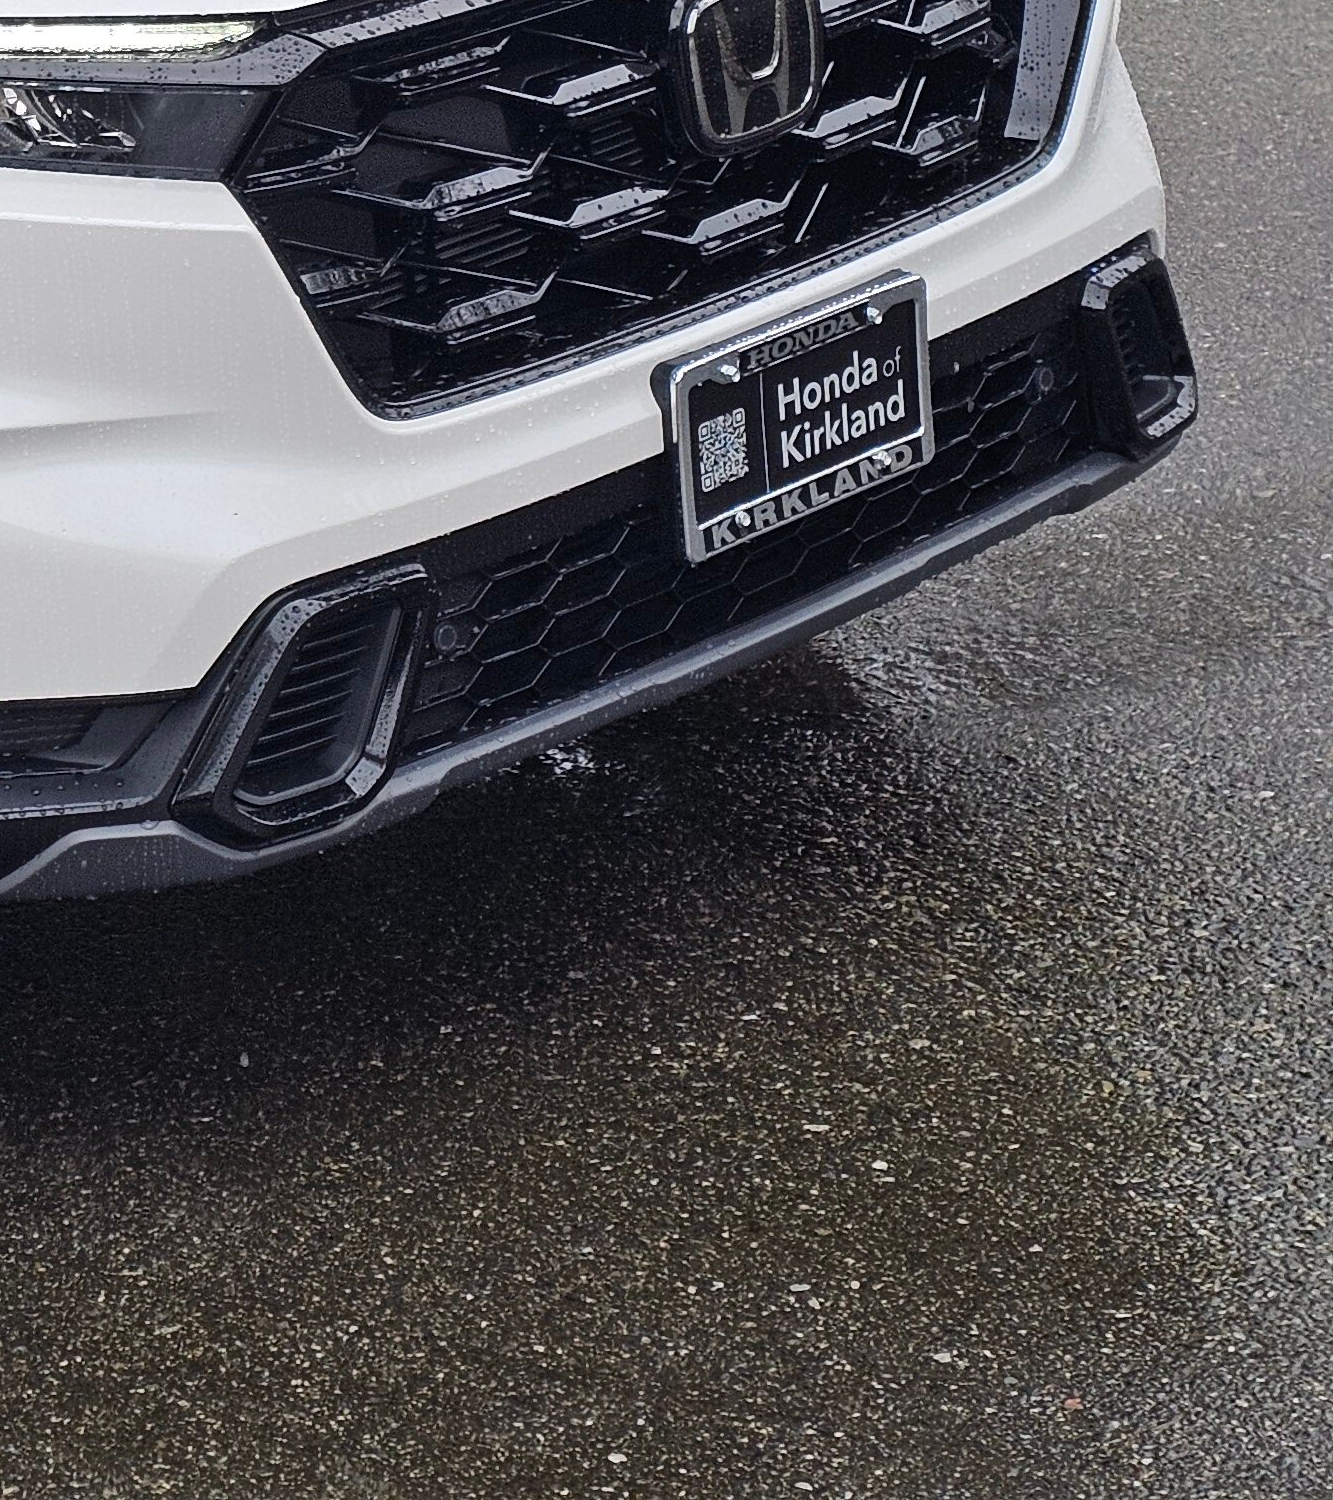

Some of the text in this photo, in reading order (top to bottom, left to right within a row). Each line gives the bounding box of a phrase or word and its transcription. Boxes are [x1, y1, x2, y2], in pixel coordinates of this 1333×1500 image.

[747, 311, 859, 370] HONDA
[777, 345, 902, 421] Honda of
[780, 379, 906, 468] Kirkland
